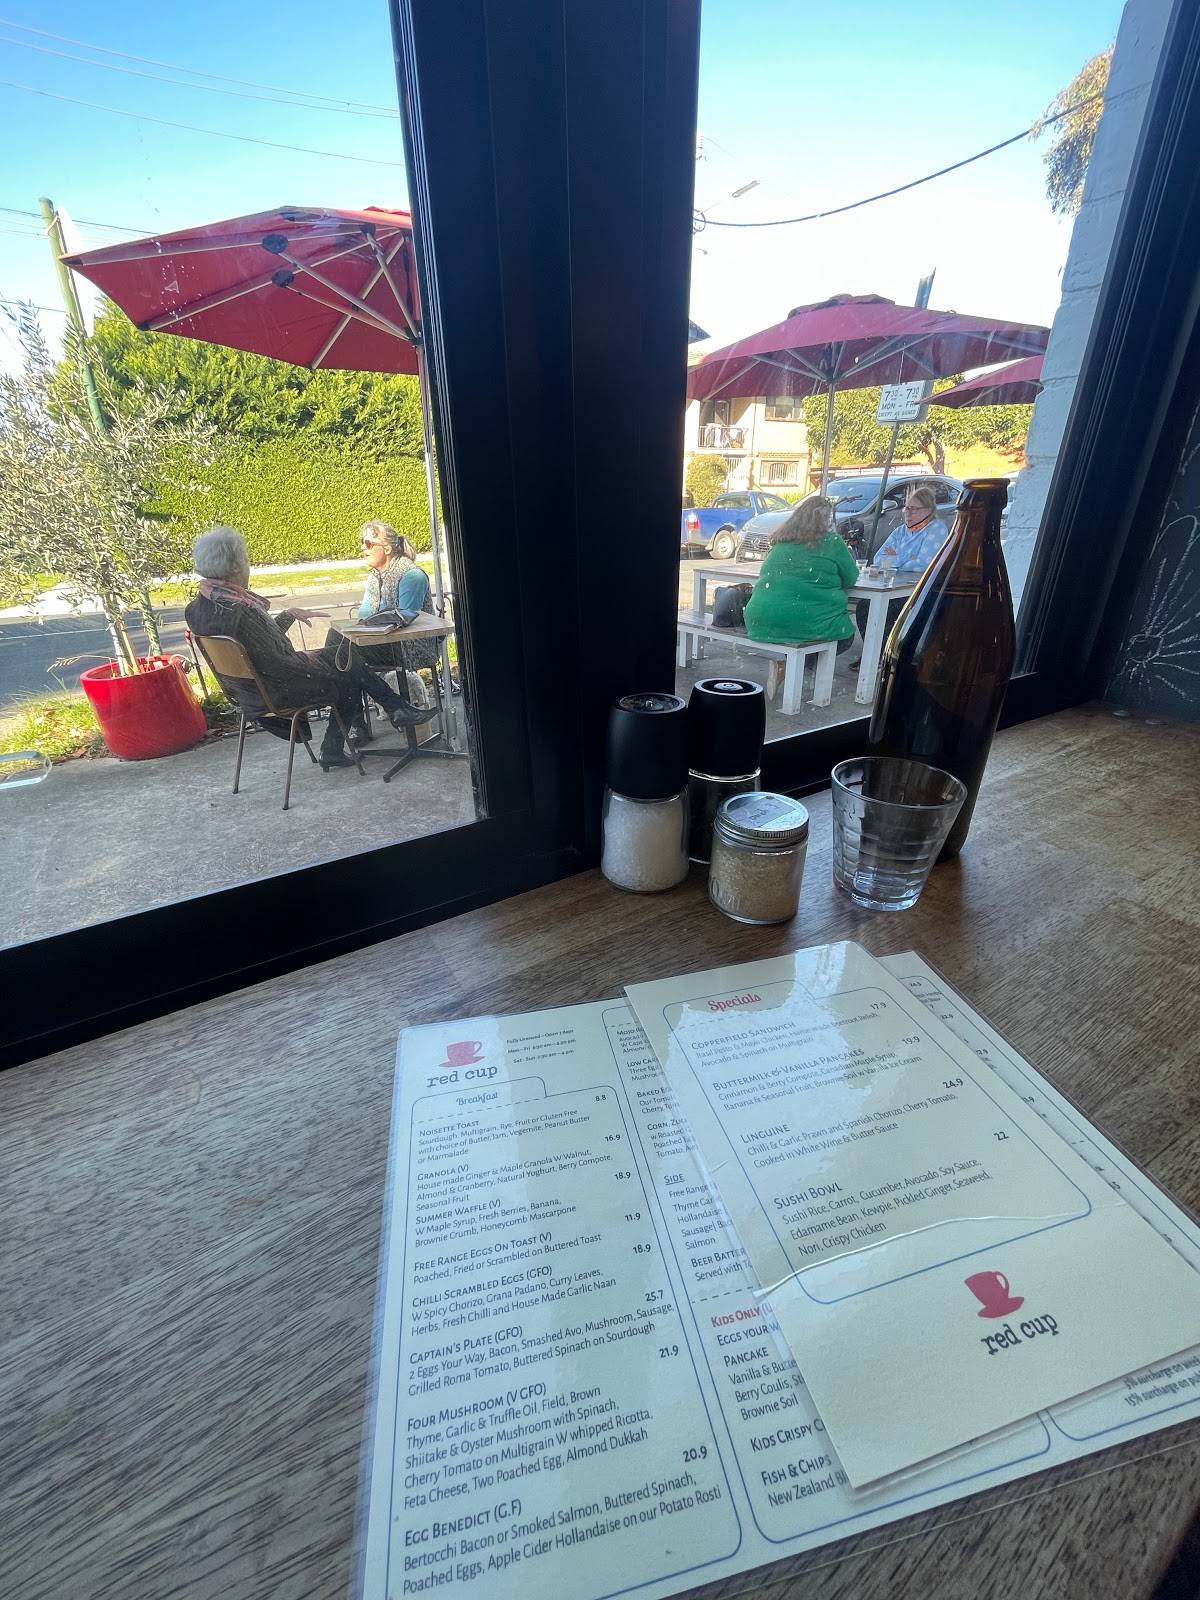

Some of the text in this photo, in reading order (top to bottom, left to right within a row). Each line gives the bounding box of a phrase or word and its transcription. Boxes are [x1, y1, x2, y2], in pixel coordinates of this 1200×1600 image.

[707, 993, 762, 1012] Specials
[691, 1032, 748, 1050] COPPERFIELD
[748, 1022, 796, 1036] SANDWICH
[426, 1064, 498, 1089] red cup
[712, 1072, 772, 1091] BUTTERMILK
[780, 1060, 820, 1074] VANILLA
[818, 1048, 865, 1064] PANCAKES
[901, 1036, 920, 1044] 19.9
[456, 1092, 498, 1106] Breakfast
[740, 1078, 964, 1143] LINGUINE 24.9
[419, 1125, 455, 1137] NOISETTE
[456, 1120, 479, 1130] TOAST
[417, 1134, 621, 1181] GRANOLA (V) 16.9
[773, 1131, 1009, 1209] SUSHI BOWL 22
[663, 1173, 684, 1183] SIDE
[782, 1159, 980, 1224] Sushi Rice, Carrot, Cucumber, Avocado, Soy Sauce,
[416, 1171, 631, 1225] SUMMER WAFFLE (V) 18.9
[790, 1170, 990, 1240] Edamame Bean, Kewpie, Pickled Ginger, Seaweed,
[414, 1212, 641, 1272] FREE RANGE EGGS ON TOAST (V) 11.9
[684, 1237, 716, 1250] Salmon
[798, 1222, 887, 1257] Nori, Crispy Chicken
[412, 1243, 652, 1308] CHILLI SCRAMBLED EGGS (GFO) 18.9
[413, 1268, 450, 1284] Poached,
[453, 1262, 475, 1274] Fried
[486, 1249, 530, 1267] Scrambled
[532, 1248, 542, 1256] on
[544, 1238, 579, 1253] Buttered
[580, 1234, 602, 1244] Toast
[690, 1256, 714, 1268] BEER
[694, 1261, 743, 1281] Served with
[463, 1334, 492, 1351] PLATE
[494, 1325, 523, 1344] (GFO)
[644, 1289, 664, 1302] 25.7
[710, 1306, 760, 1328] KIDS ONLY
[409, 1303, 672, 1379] 2 Eggs Your Way, Bacon, Smashed Avo, Mushroom, Sausage,
[716, 1324, 769, 1346] EGGS YOUR
[980, 1314, 1059, 1356] red cup
[723, 1346, 769, 1368] PANCAKE
[728, 1358, 798, 1385] Vanilla & Butte
[407, 1344, 679, 1432] FOUR MUSHROOM (V GFO) 21.9
[734, 1378, 793, 1403] Berry Coulis,
[406, 1387, 601, 1450] Thyme, Garlic & Truffle Oil, Field, Brown
[740, 1392, 799, 1421] Brownie Soil
[750, 1424, 812, 1452] KIDS CRISPY
[760, 1454, 832, 1486] FISH & CHIPS
[405, 1445, 708, 1547] EGG BENEDICT (G.F) 20.9
[768, 1473, 836, 1507] New Zealand
[404, 1472, 697, 1572] Bertocchi Bacon or Smoked Salmon, Buttered Spinach,
[403, 1487, 722, 1596] Poached Eggs, Apple Cider Hollandaise on our Potato Rosti
